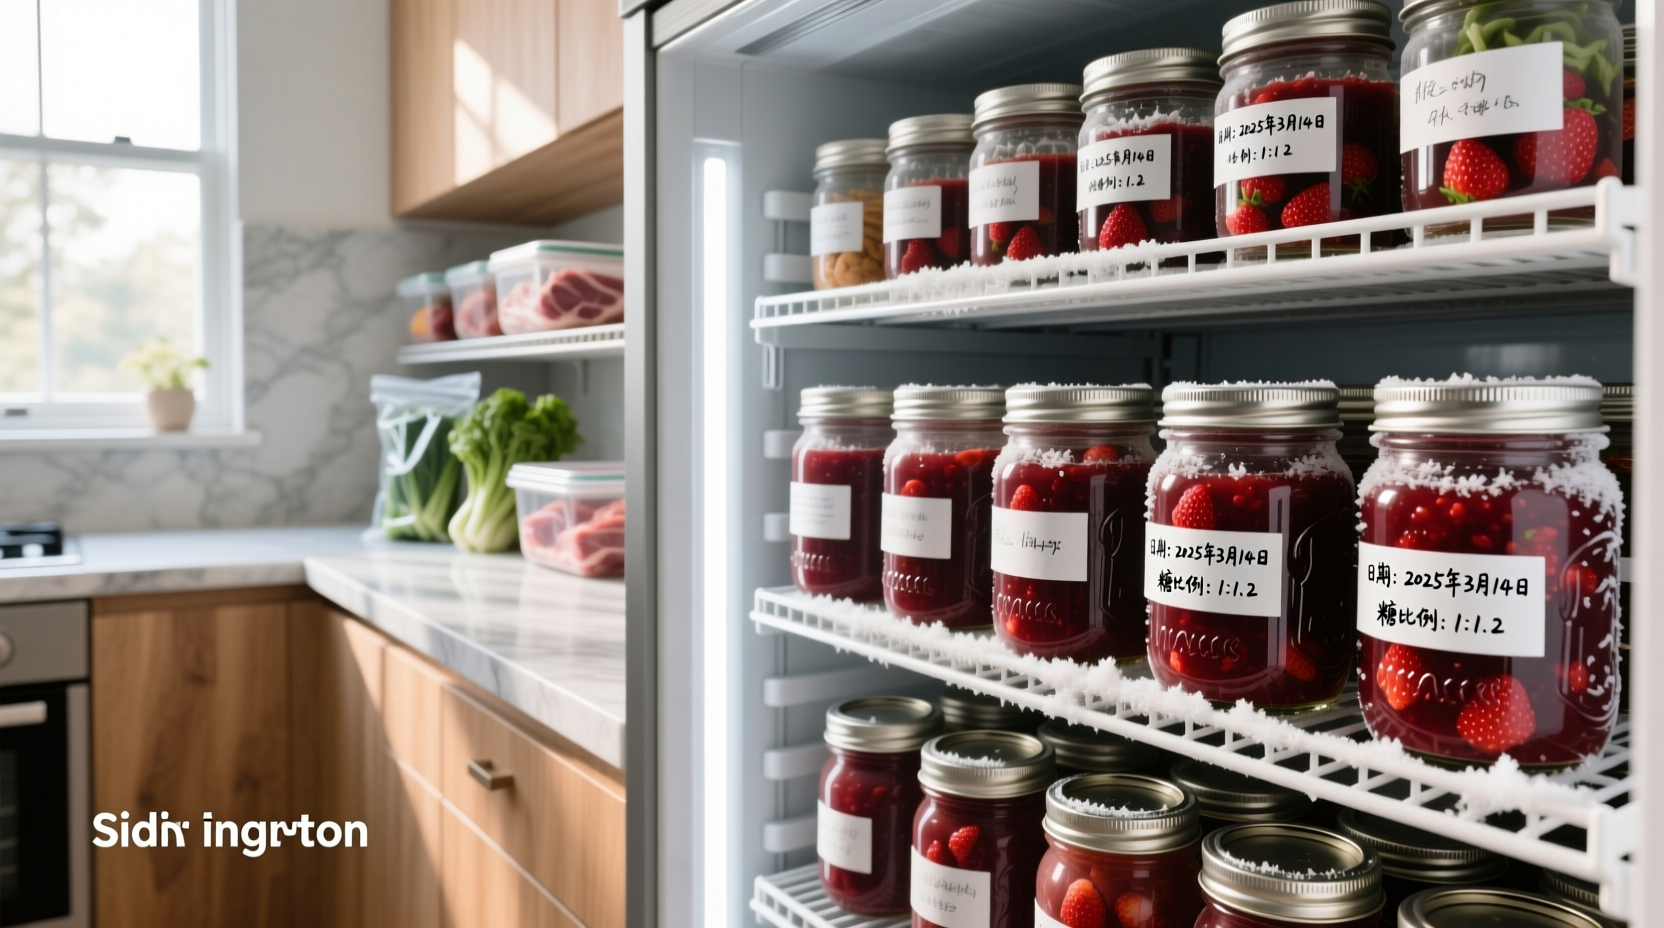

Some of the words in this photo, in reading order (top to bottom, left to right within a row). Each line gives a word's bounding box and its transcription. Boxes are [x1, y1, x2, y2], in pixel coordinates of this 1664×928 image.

[1218, 579, 1258, 598] 1:1.2
[1367, 561, 1397, 588] 日期:
[1404, 567, 1529, 598] 2025年3月14日
[1376, 600, 1446, 632] 糖比例:
[1454, 613, 1505, 634] 1:1.2
